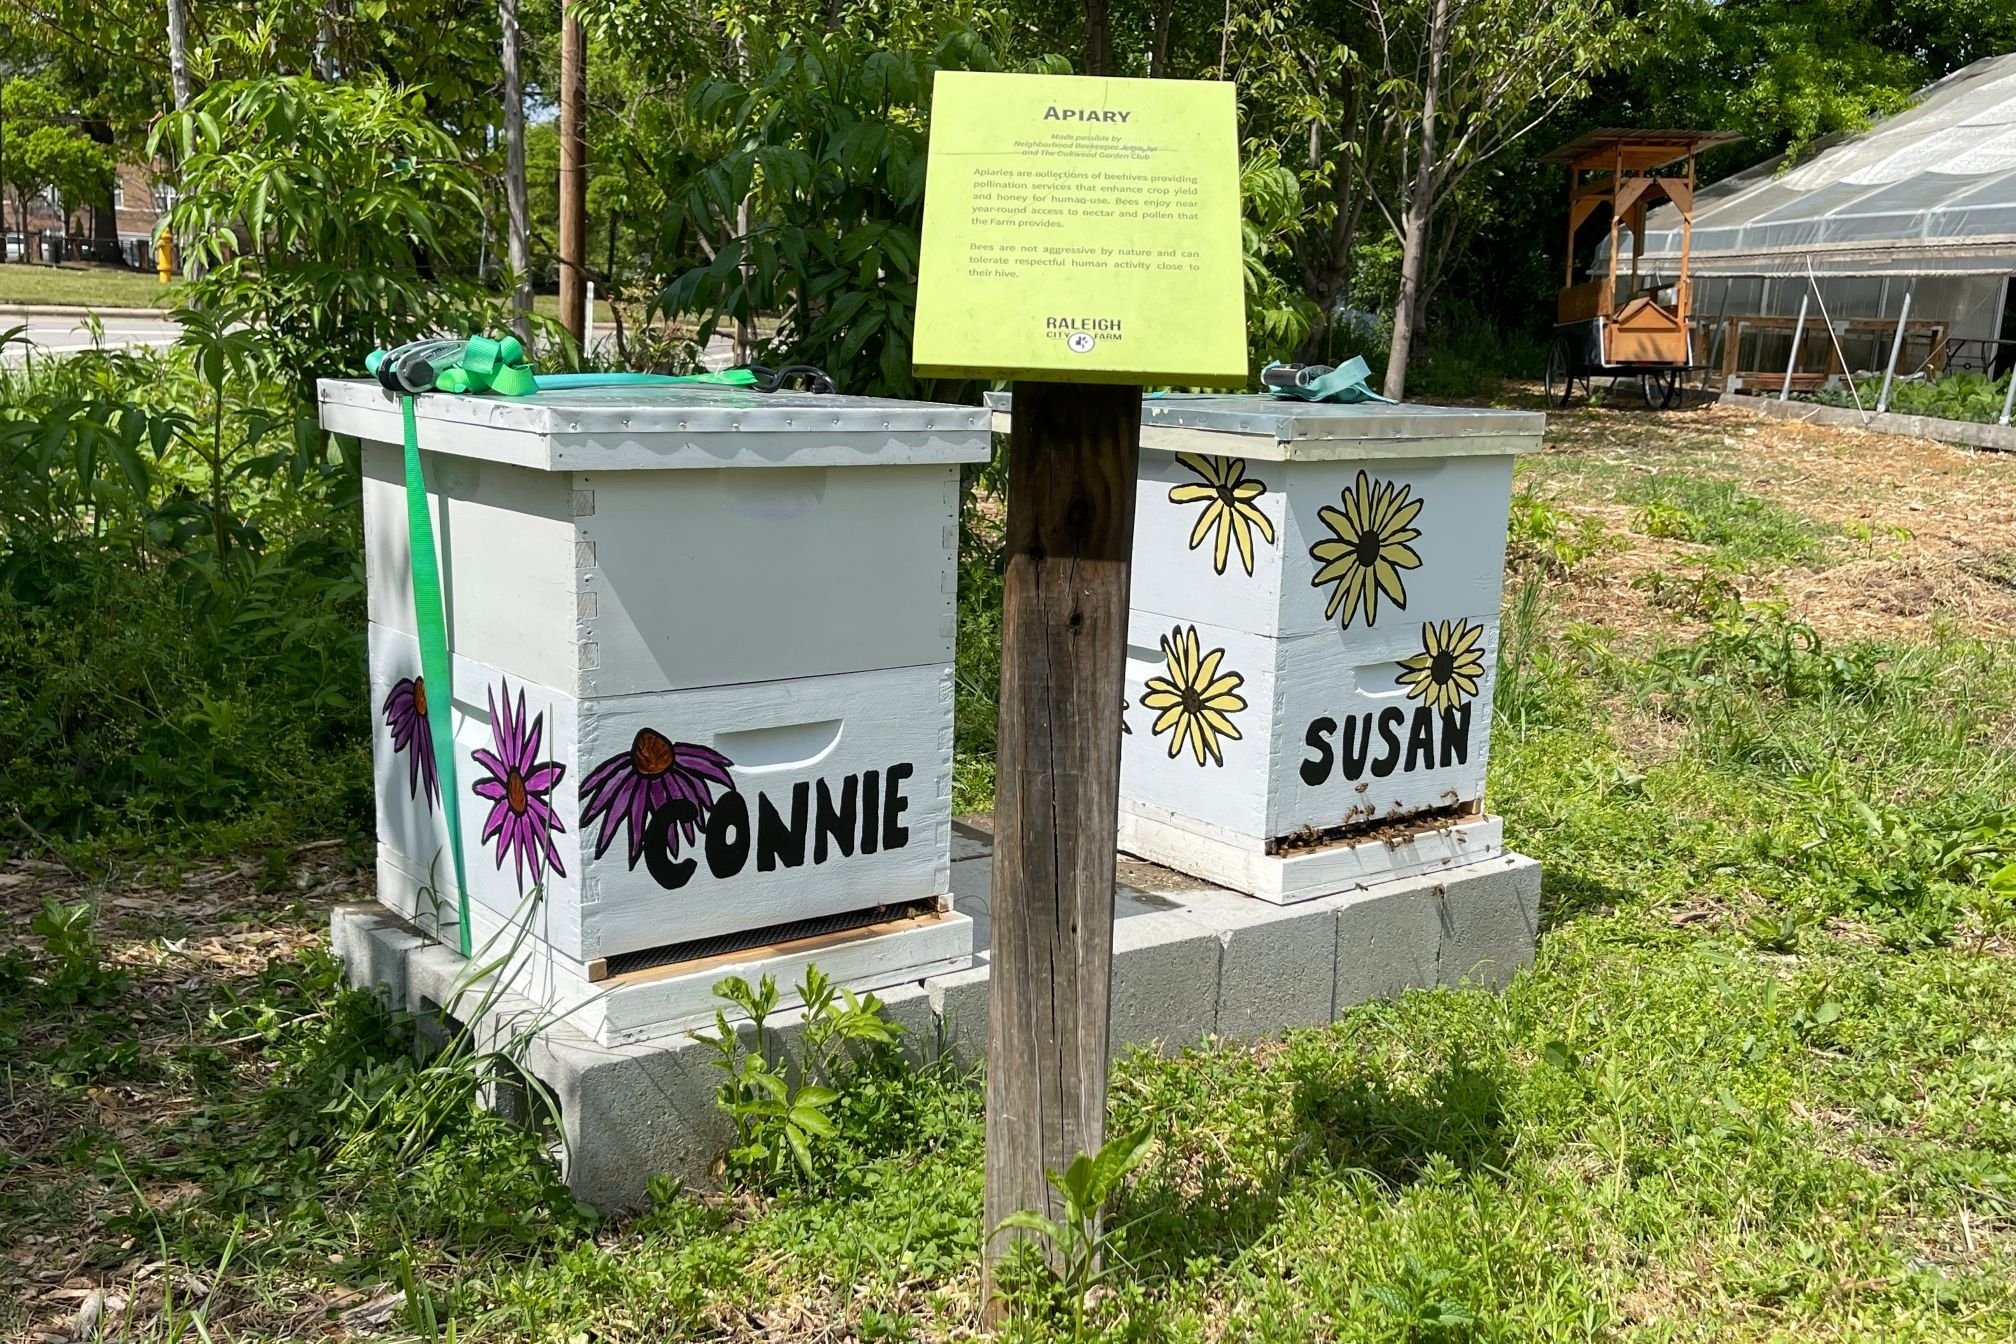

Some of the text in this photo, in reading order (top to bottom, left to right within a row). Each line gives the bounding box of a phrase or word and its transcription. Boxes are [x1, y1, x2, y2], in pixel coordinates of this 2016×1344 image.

[1043, 106, 1132, 123] APIARY
[1051, 133, 1122, 143] Made possible by
[1014, 140, 1074, 150] Neighborhood
[1076, 143, 1119, 152] Beekeeper
[1058, 150, 1097, 158] Oakwood
[1099, 152, 1129, 160] Garden
[1130, 152, 1150, 160] Club
[974, 168, 1014, 177] Apiaries
[1036, 170, 1088, 179] collections
[1104, 172, 1148, 181] beehives
[1151, 175, 1198, 184] providing
[974, 180, 1198, 196] pollination services that enhance crop yield
[996, 193, 1028, 202] honey
[1032, 194, 1046, 202] for
[1116, 198, 1139, 206] Bees
[1144, 199, 1171, 208] enjoy
[972, 206, 1027, 214] year-round
[1142, 211, 1174, 220] pollen
[1178, 212, 1198, 220] that
[990, 218, 1016, 226] Farm
[1018, 219, 1064, 228] provides.
[1043, 246, 1096, 255] aggressive
[1101, 248, 1114, 256] by
[1118, 248, 1152, 256] nature
[1157, 249, 1176, 257] and
[969, 256, 1200, 271] tolerate respectful human activity close to
[968, 268, 1020, 278] their hive.
[1046, 316, 1122, 331] RALEIGH
[1300, 700, 1472, 786] SUSAN
[644, 762, 914, 890] CONNIE
